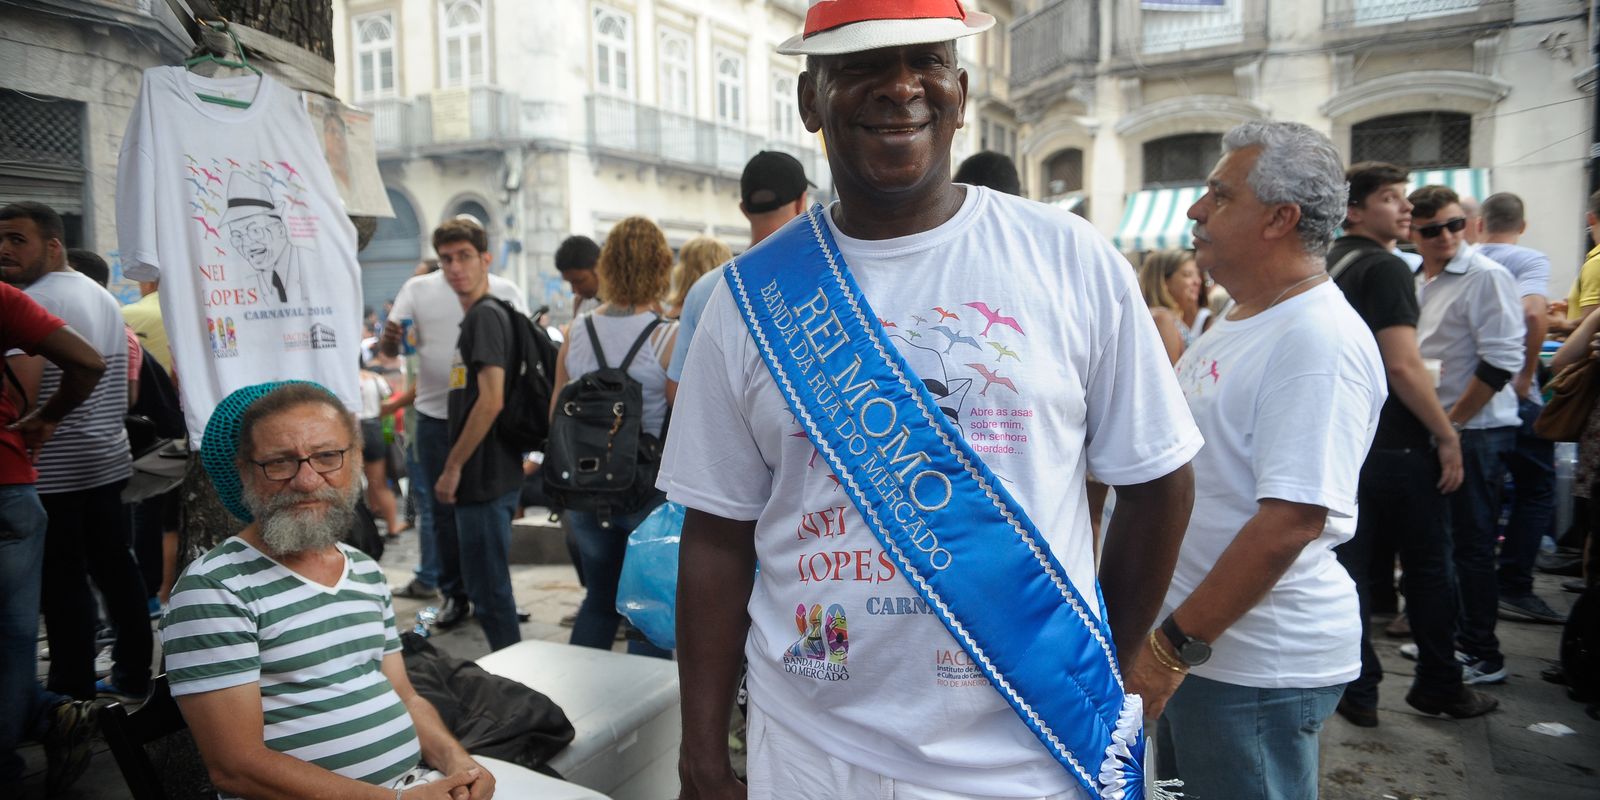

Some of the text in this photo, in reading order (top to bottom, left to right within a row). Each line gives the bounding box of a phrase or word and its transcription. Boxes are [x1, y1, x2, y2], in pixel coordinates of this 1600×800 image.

[200, 264, 225, 281] NEI
[202, 288, 258, 307] LOPES
[244, 306, 333, 320] CARNAVAL 2016
[793, 287, 952, 512] REI MOMO
[970, 407, 1034, 417] Abre as asas
[760, 278, 952, 570] BANDA DA RUA DO MERCADO
[970, 420, 1024, 431] sobre mim,
[971, 432, 1027, 443] Oh senhora
[797, 506, 846, 540] NEI
[798, 548, 896, 585] LOPES
[783, 656, 849, 673] BANDA DA RUA
[785, 664, 850, 681] DO MERCADO
[937, 665, 964, 673] Instituto
